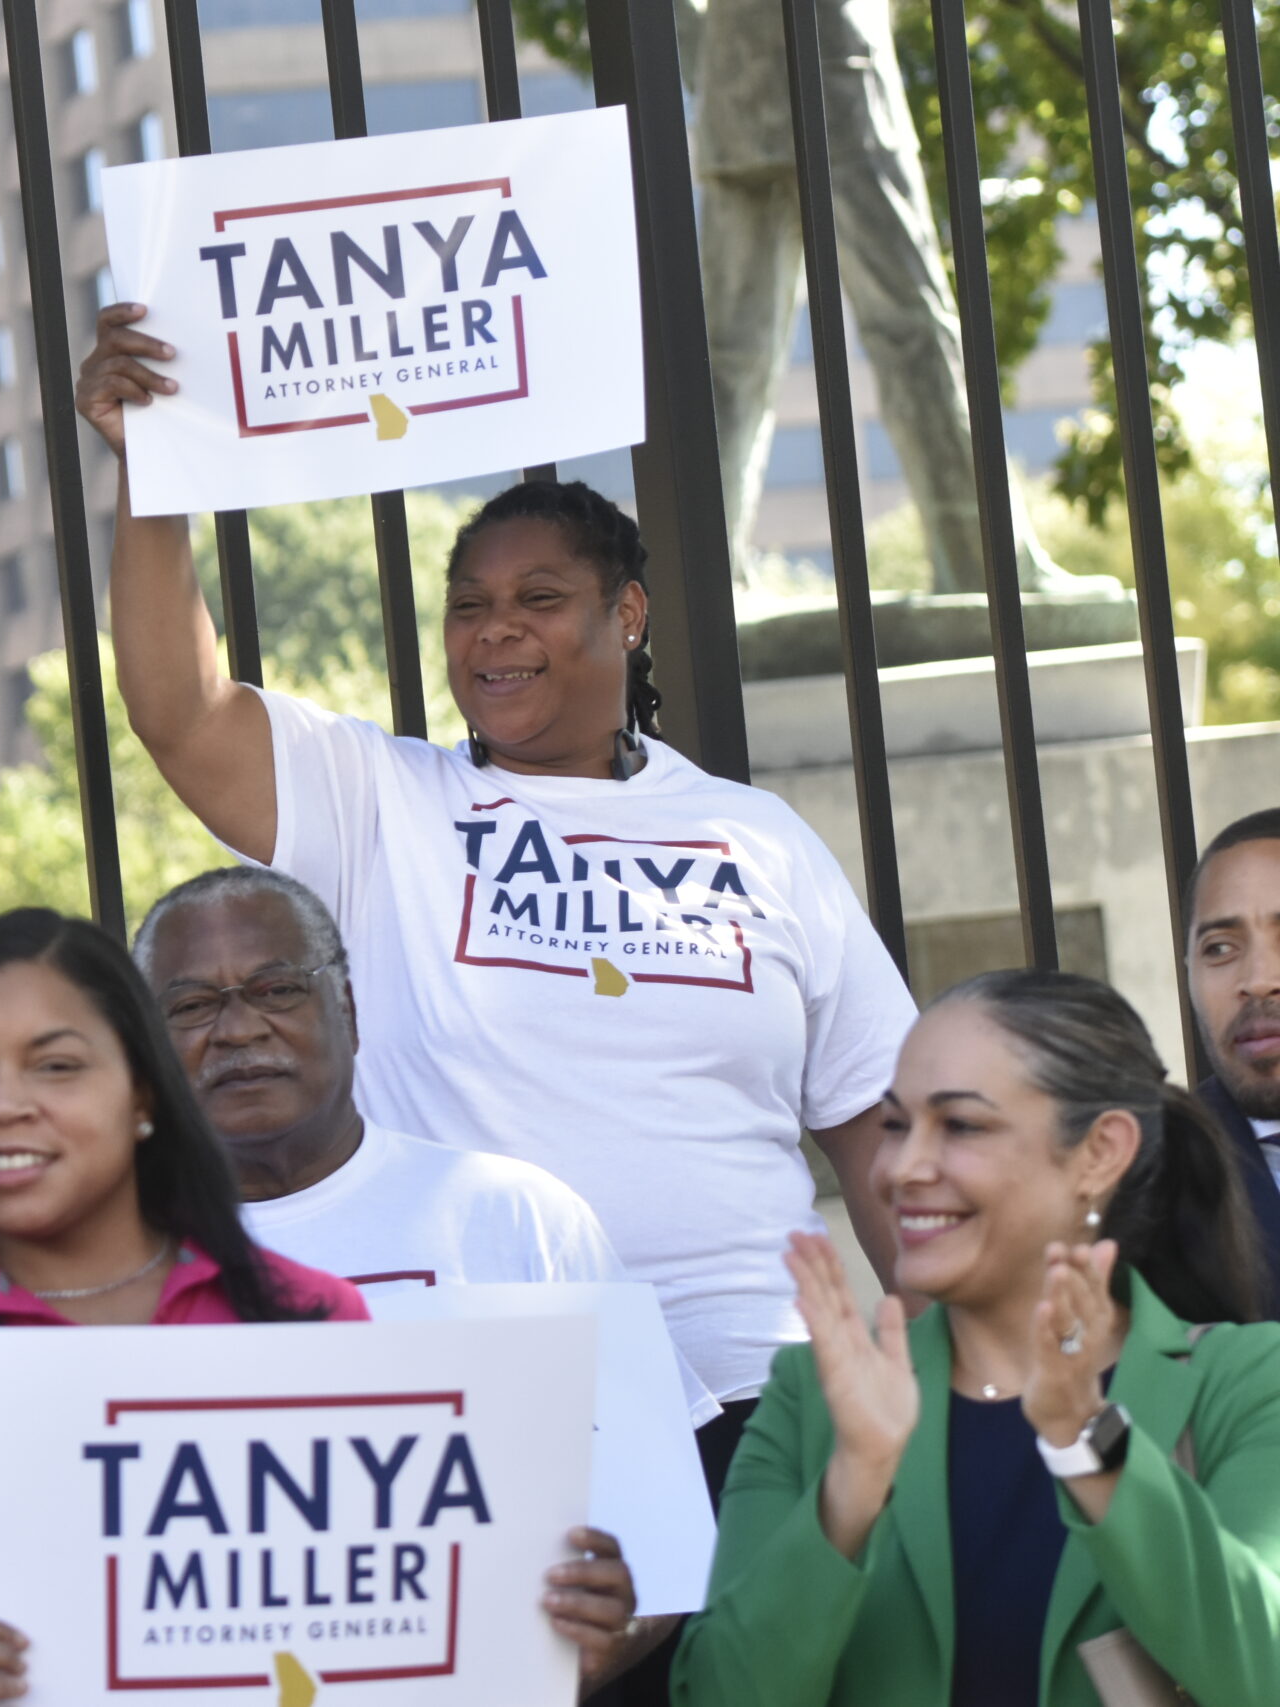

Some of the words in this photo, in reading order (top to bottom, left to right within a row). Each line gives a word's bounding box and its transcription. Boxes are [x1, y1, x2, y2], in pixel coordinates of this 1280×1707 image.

[199, 209, 548, 320] TANYA
[260, 298, 498, 374] MILLER
[264, 371, 386, 400] ATTORNEY
[396, 355, 499, 383] GENERAL
[488, 923, 609, 952] ATTORNEY
[623, 942, 728, 960] GENERAL
[82, 1432, 493, 1538] TANYA
[144, 1542, 428, 1612] MILLER
[144, 1622, 293, 1646] ATTORNEY
[307, 1616, 428, 1640] GENERAL
